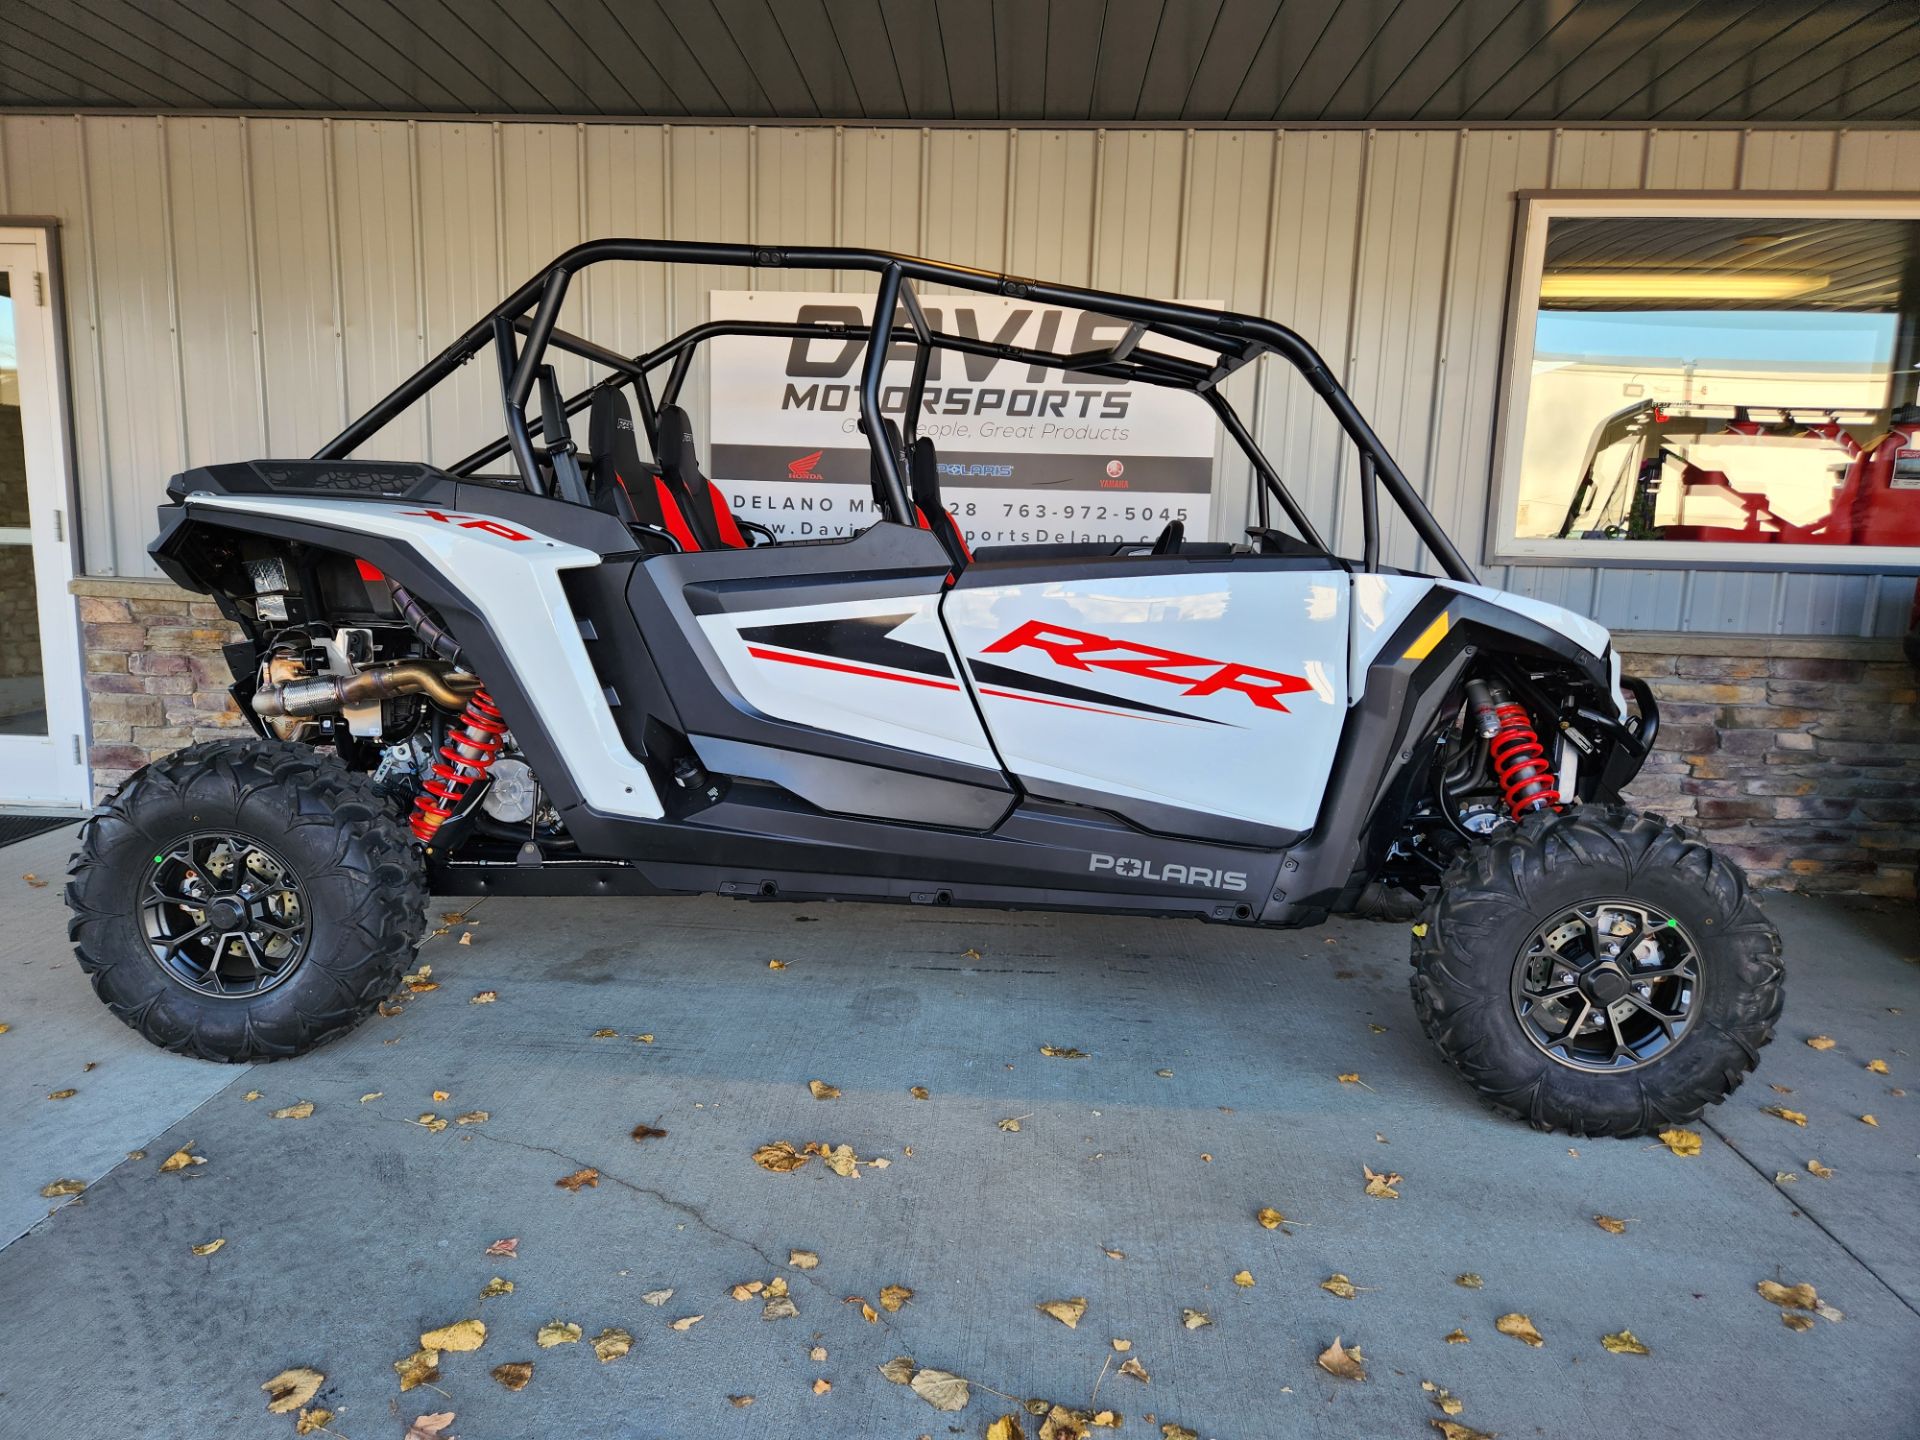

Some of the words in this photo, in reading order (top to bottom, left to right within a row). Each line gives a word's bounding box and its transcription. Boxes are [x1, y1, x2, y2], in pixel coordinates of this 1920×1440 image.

[781, 383, 1132, 419] MOORSPORTS
[916, 421, 972, 440] eople,
[979, 421, 1035, 439] Great
[1041, 422, 1130, 441] Products
[936, 463, 1013, 477] POLARIS
[1100, 479, 1129, 489] YAMAHA
[733, 494, 833, 512] DELANO
[1003, 503, 1187, 522] 763-972-5045
[393, 509, 534, 542] XP
[979, 619, 1315, 714] RZR
[1088, 853, 1248, 891] POLARIS
